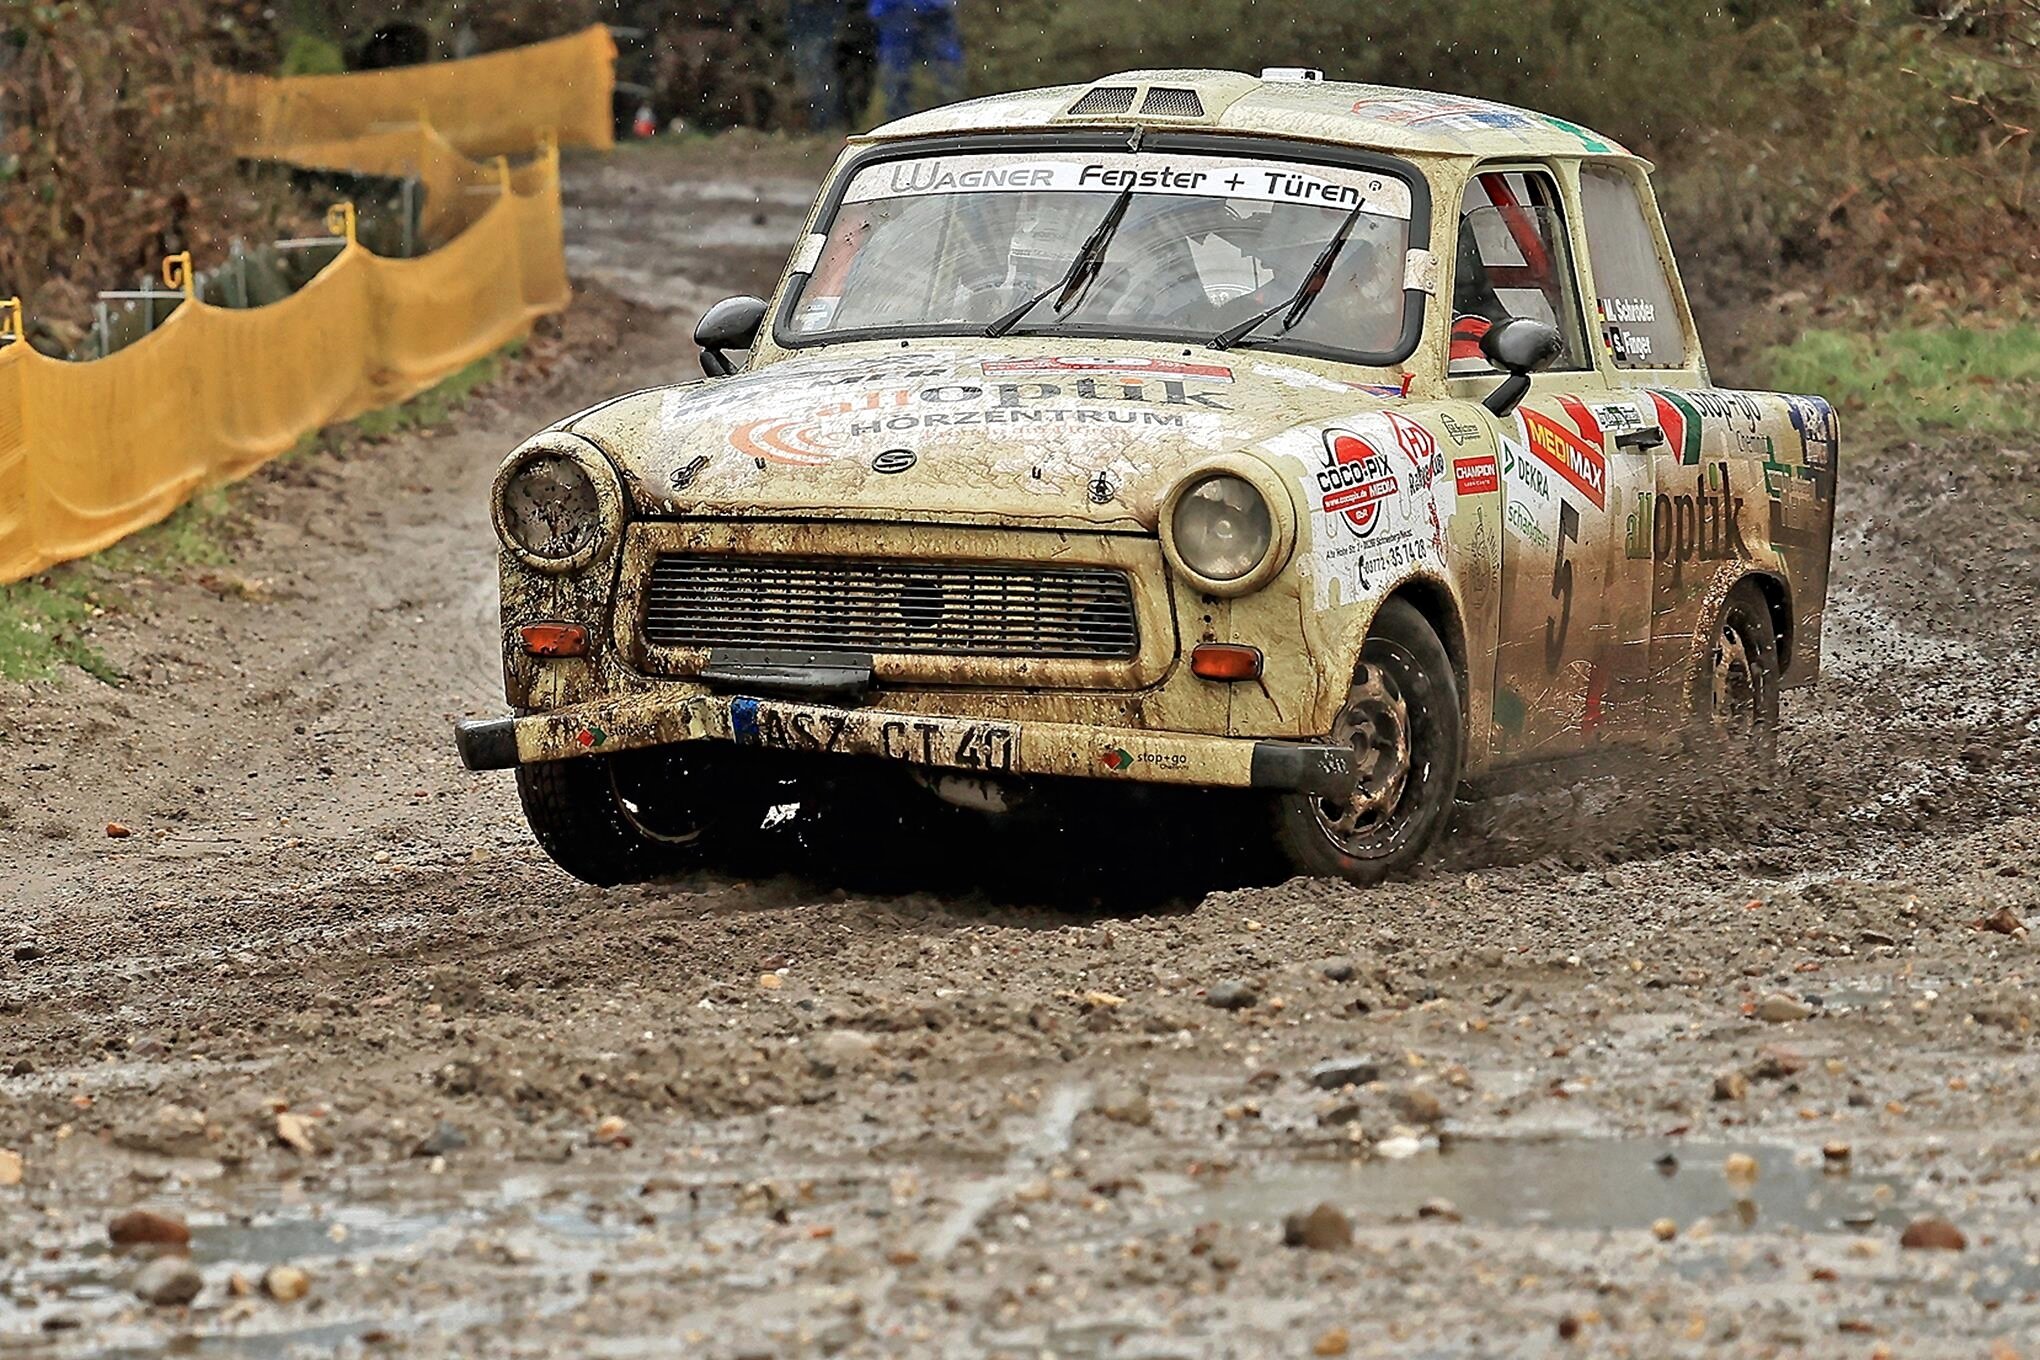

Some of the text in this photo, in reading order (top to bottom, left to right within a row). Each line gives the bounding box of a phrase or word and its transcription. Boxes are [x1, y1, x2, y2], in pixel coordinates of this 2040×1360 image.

[891, 161, 1054, 193] WAGNER
[1078, 164, 1207, 190] Fenster
[1225, 173, 1245, 191] +
[851, 409, 1184, 437] HÖRZENTRUM
[1527, 418, 1602, 495] MEDIMAX
[1456, 463, 1496, 479] CHAMPION
[1517, 455, 1549, 501] DEKRA
[1389, 546, 1403, 567] 35
[1137, 752, 1188, 765] stop+go
